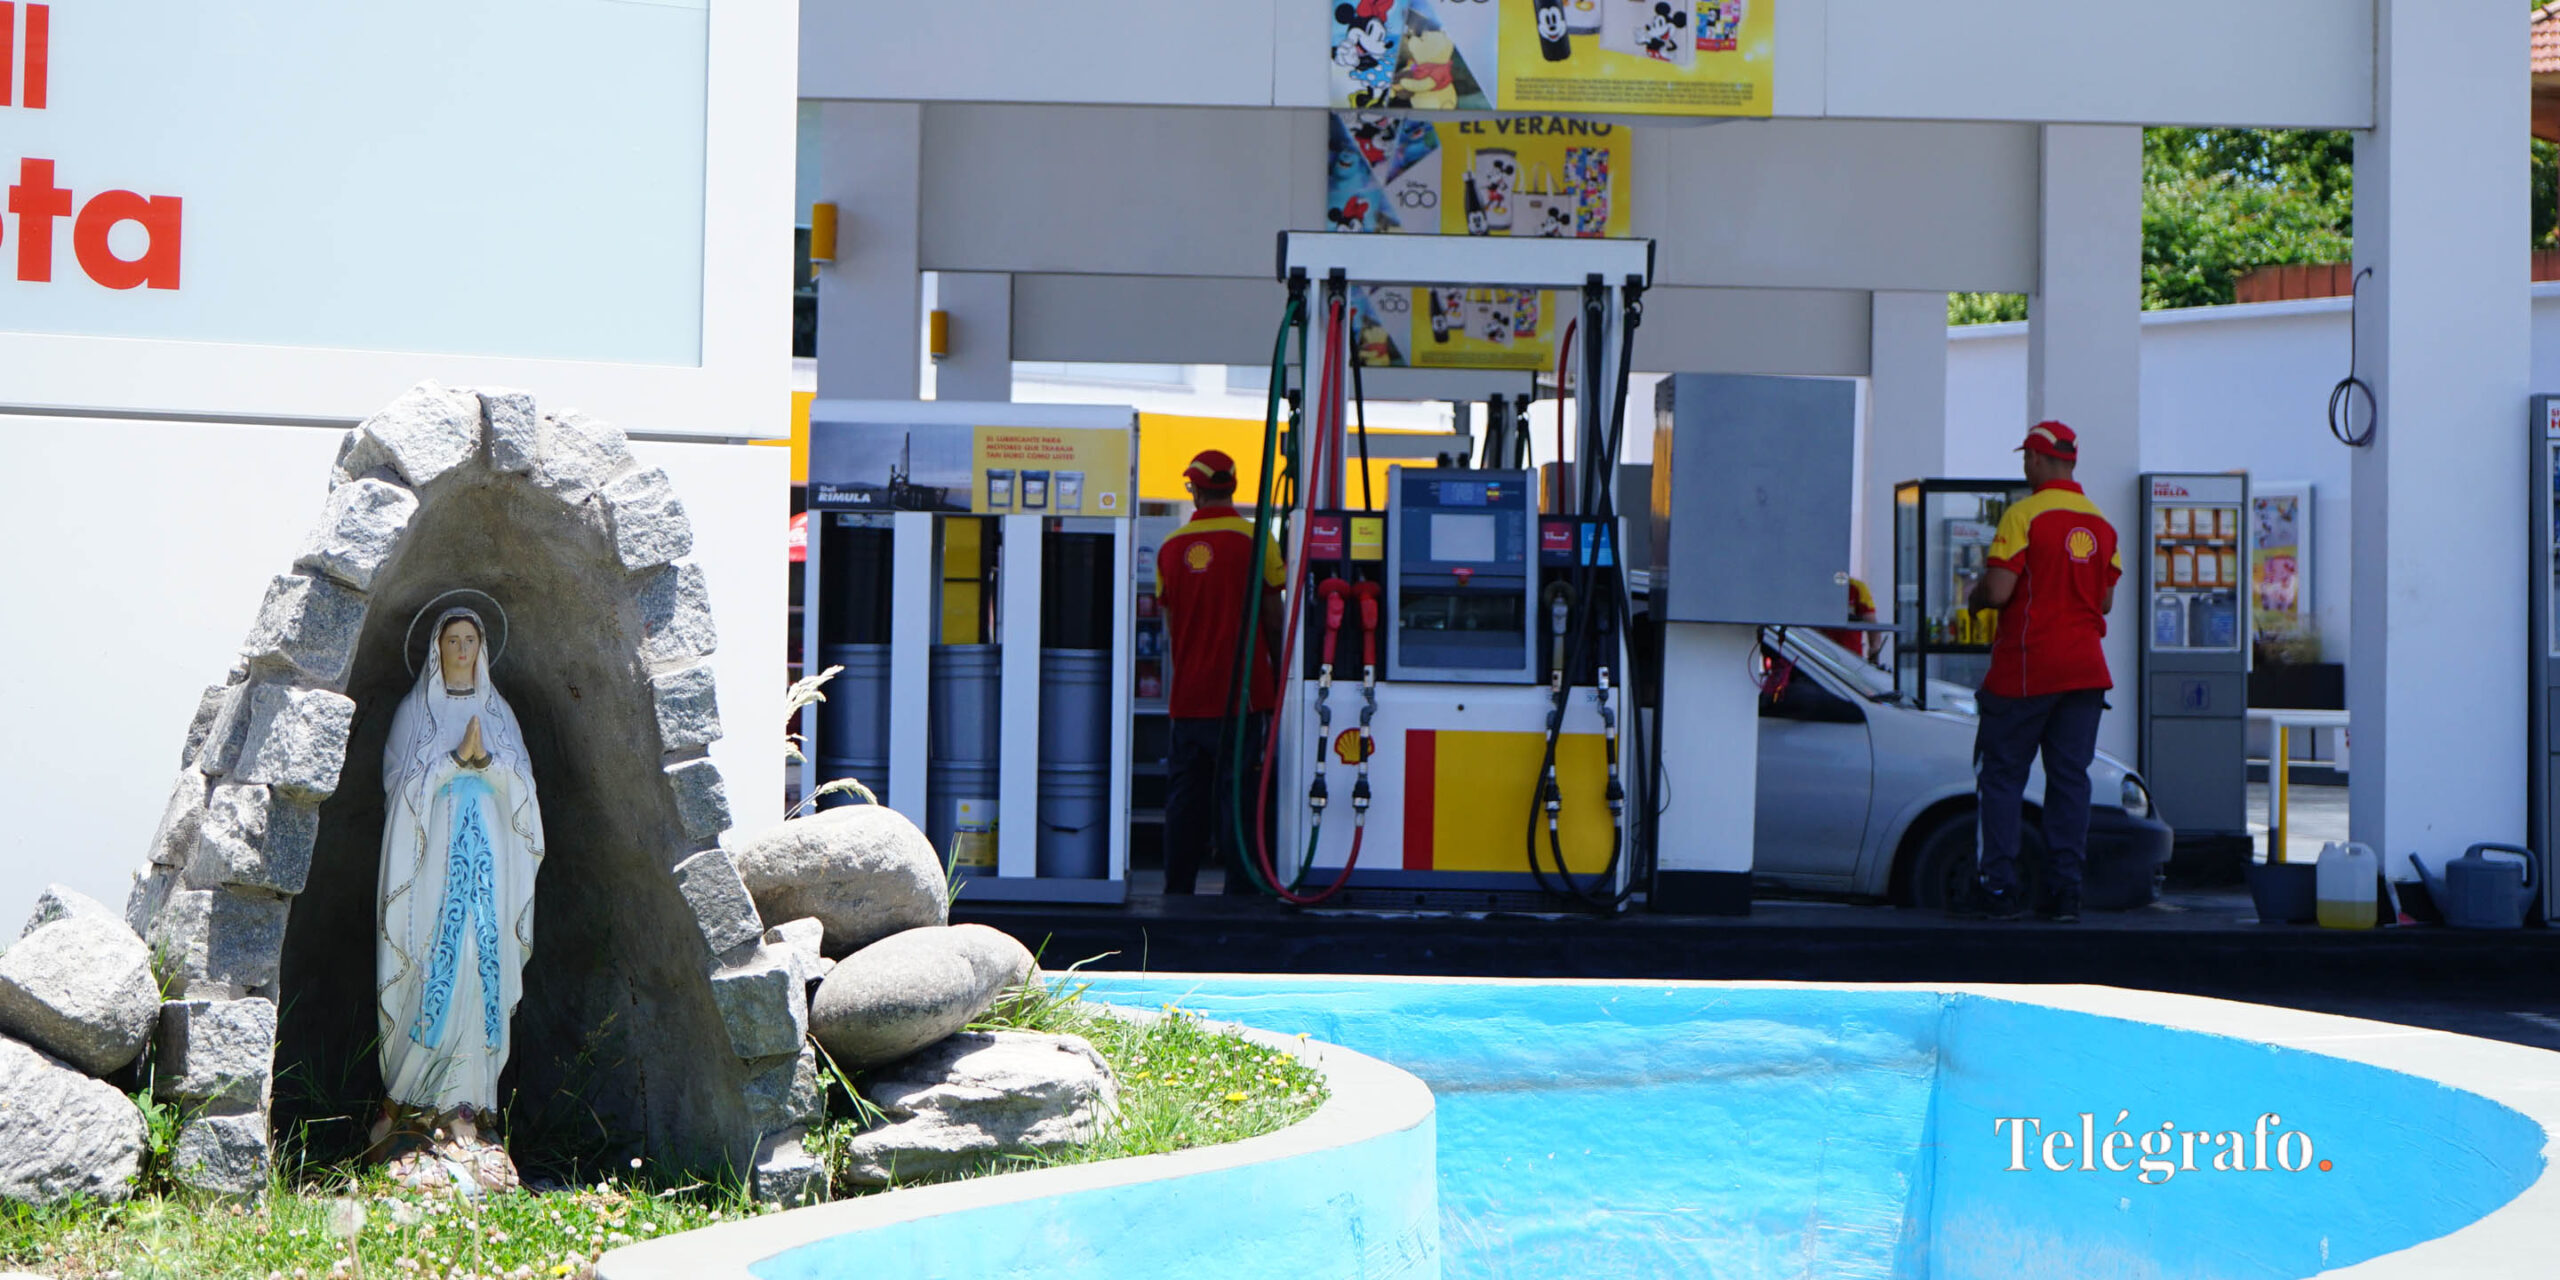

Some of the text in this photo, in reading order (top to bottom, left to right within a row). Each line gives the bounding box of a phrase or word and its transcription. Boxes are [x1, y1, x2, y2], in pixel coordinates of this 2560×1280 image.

[1496, 116, 1613, 137] VERANO
[1396, 190, 1438, 209] 100
[1379, 299, 1409, 313] 100
[818, 492, 871, 503] RIMULA
